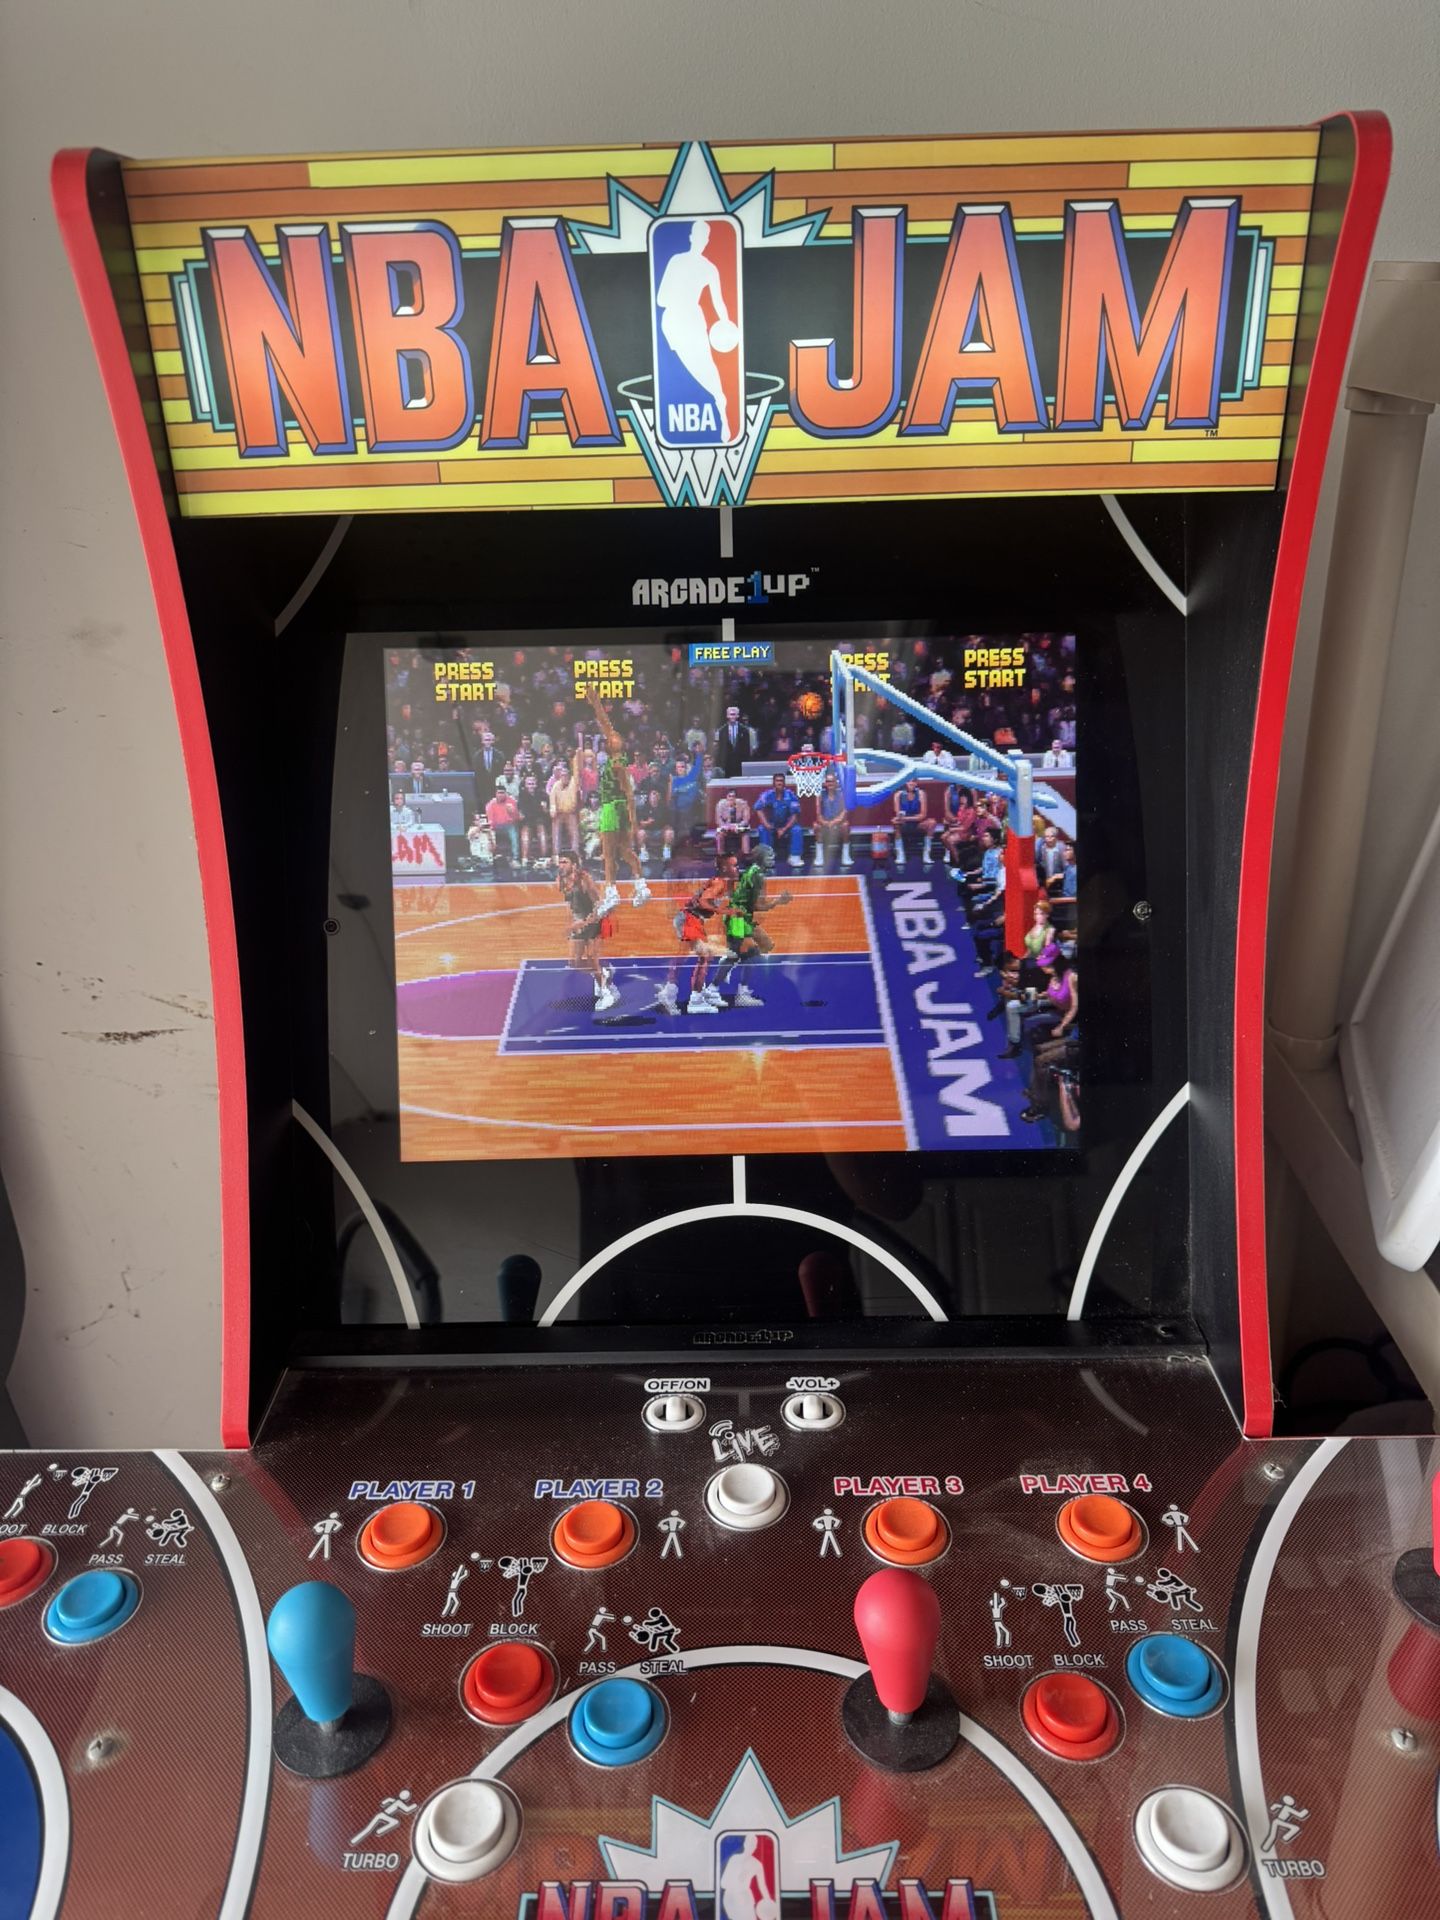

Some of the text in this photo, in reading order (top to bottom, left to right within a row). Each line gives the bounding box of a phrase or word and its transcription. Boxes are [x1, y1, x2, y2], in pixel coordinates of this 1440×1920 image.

[200, 214, 626, 459] NBA
[788, 196, 1243, 440] JAM
[667, 402, 717, 433] NBA
[631, 570, 810, 609] ARCADE1UP
[695, 645, 770, 661] FREE PLAY
[830, 652, 890, 672] RESS
[964, 648, 1025, 668] PRESS
[434, 662, 495, 681] PRESS
[574, 660, 634, 679] PRESS
[964, 668, 1027, 689] START
[435, 683, 497, 702] START
[885, 881, 1011, 1137] NBA JAM
[646, 1380, 709, 1391] OFF/ON
[711, 1424, 781, 1463] LIVE
[348, 1480, 476, 1500] PLAYER 1
[534, 1479, 664, 1499] PLAYER 2
[833, 1475, 965, 1496] PLAYER 3
[1019, 1473, 1152, 1494] PLAYER 4
[42, 1523, 88, 1535] BLOCK
[88, 1554, 186, 1566] PASS STEAL
[422, 1623, 539, 1637] SHOOT BLOCK
[1110, 1619, 1218, 1633] PASS STEAL
[579, 1660, 687, 1675] PASS STEAL
[983, 1654, 1105, 1668] SHOOT BLOCK
[343, 1852, 400, 1869] TURBO
[1264, 1860, 1326, 1878] TURBO
